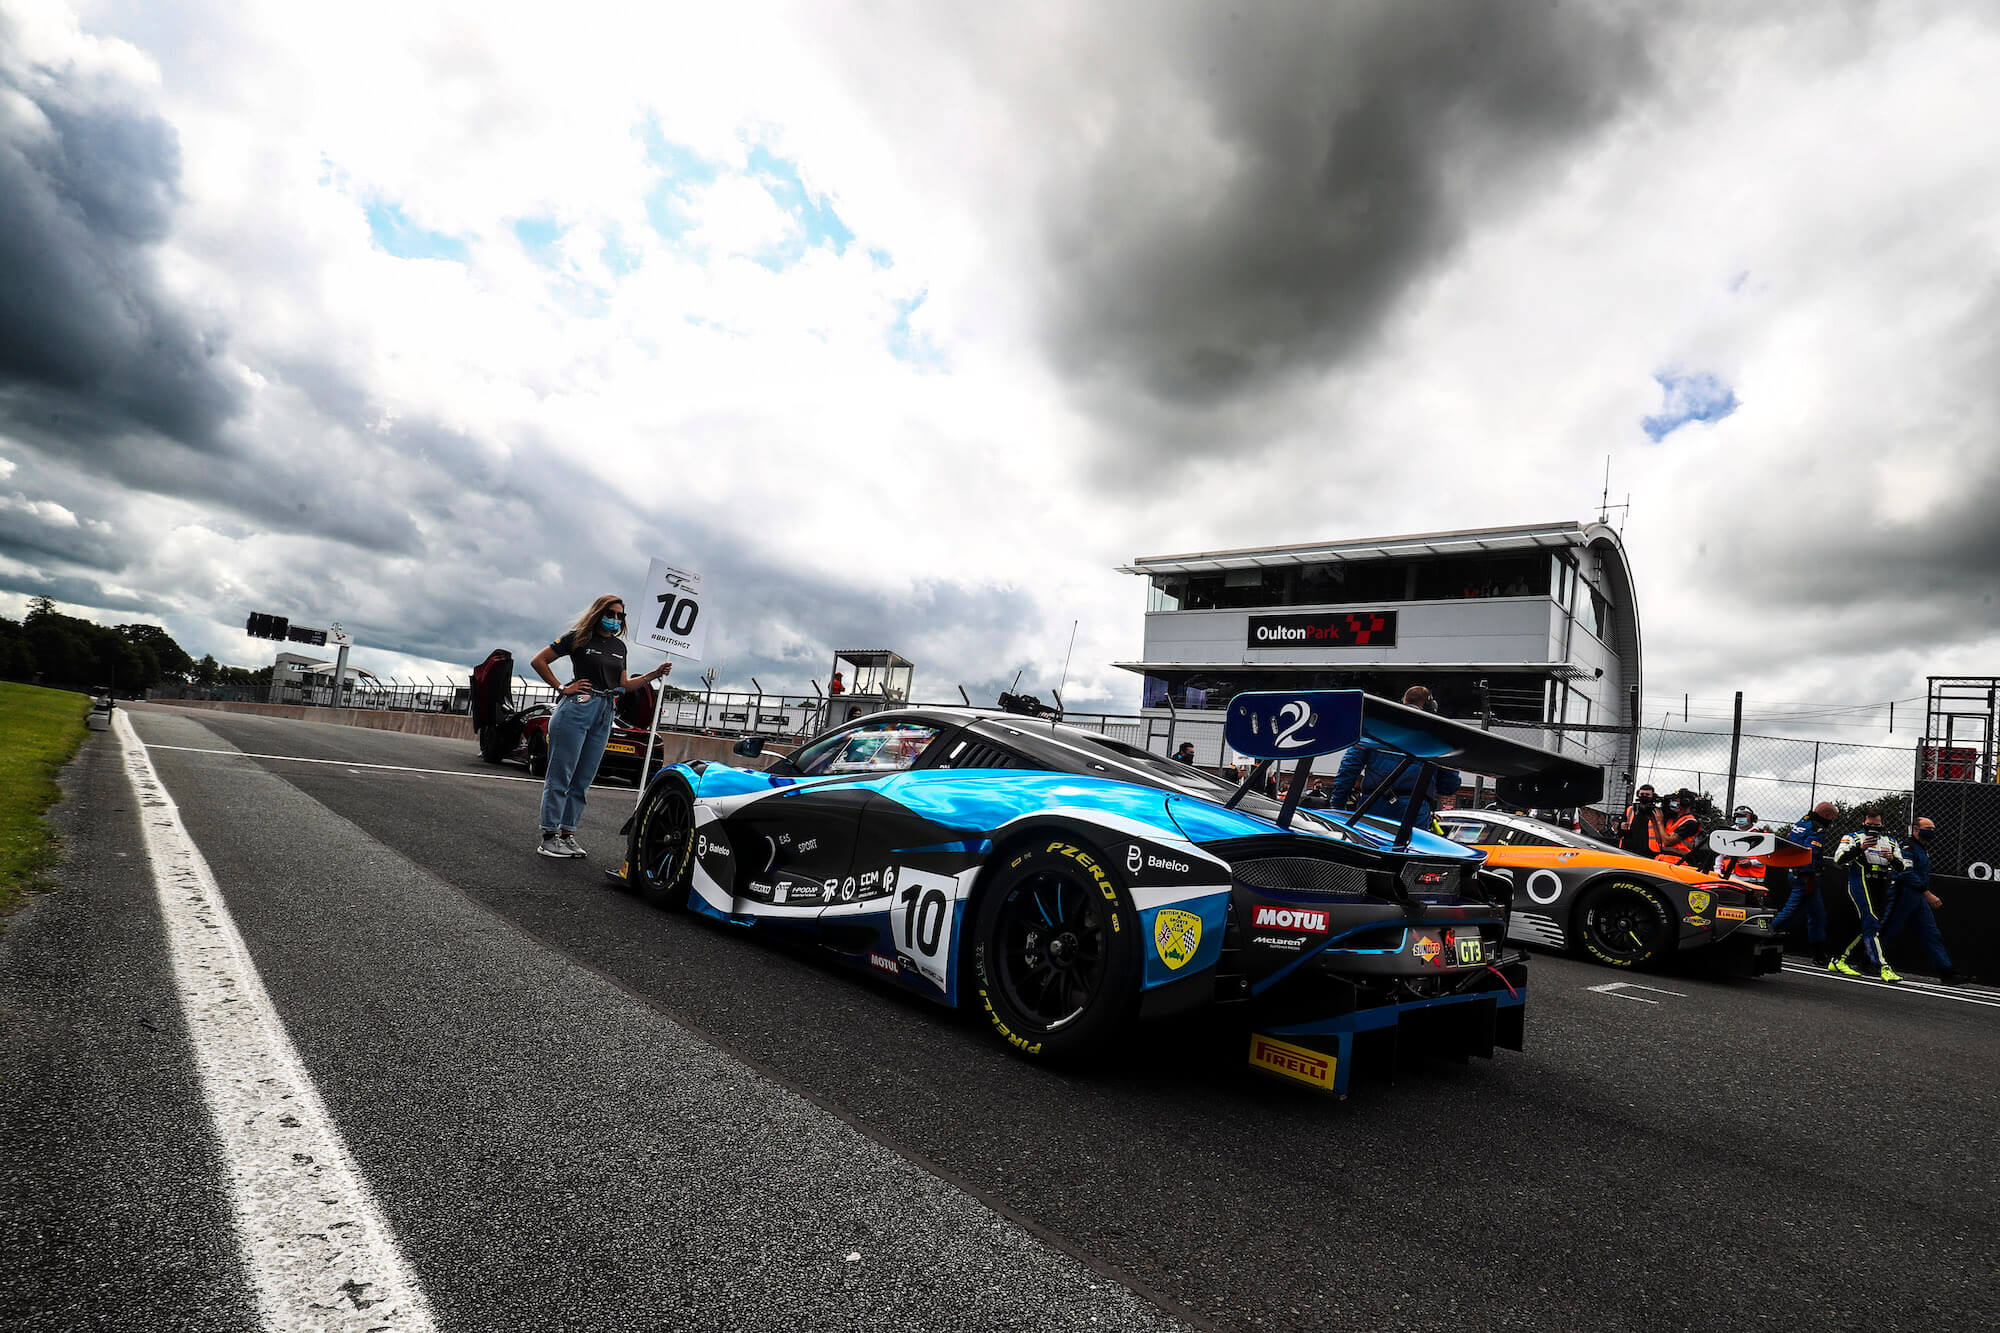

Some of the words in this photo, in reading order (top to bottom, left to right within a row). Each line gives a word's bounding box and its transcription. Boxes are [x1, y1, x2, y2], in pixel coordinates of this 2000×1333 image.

[655, 593, 699, 636] 10
[651, 633, 691, 649] #BRITISHGT
[709, 843, 730, 856] Batelco
[1148, 855, 1189, 872] Batelco
[901, 884, 946, 957] 10
[1256, 908, 1326, 930] MOTUL
[1253, 937, 1301, 946] McLaren
[1461, 941, 1481, 962] GT3
[871, 954, 899, 973] MOTUL
[1256, 1041, 1328, 1080] PIRELLI
